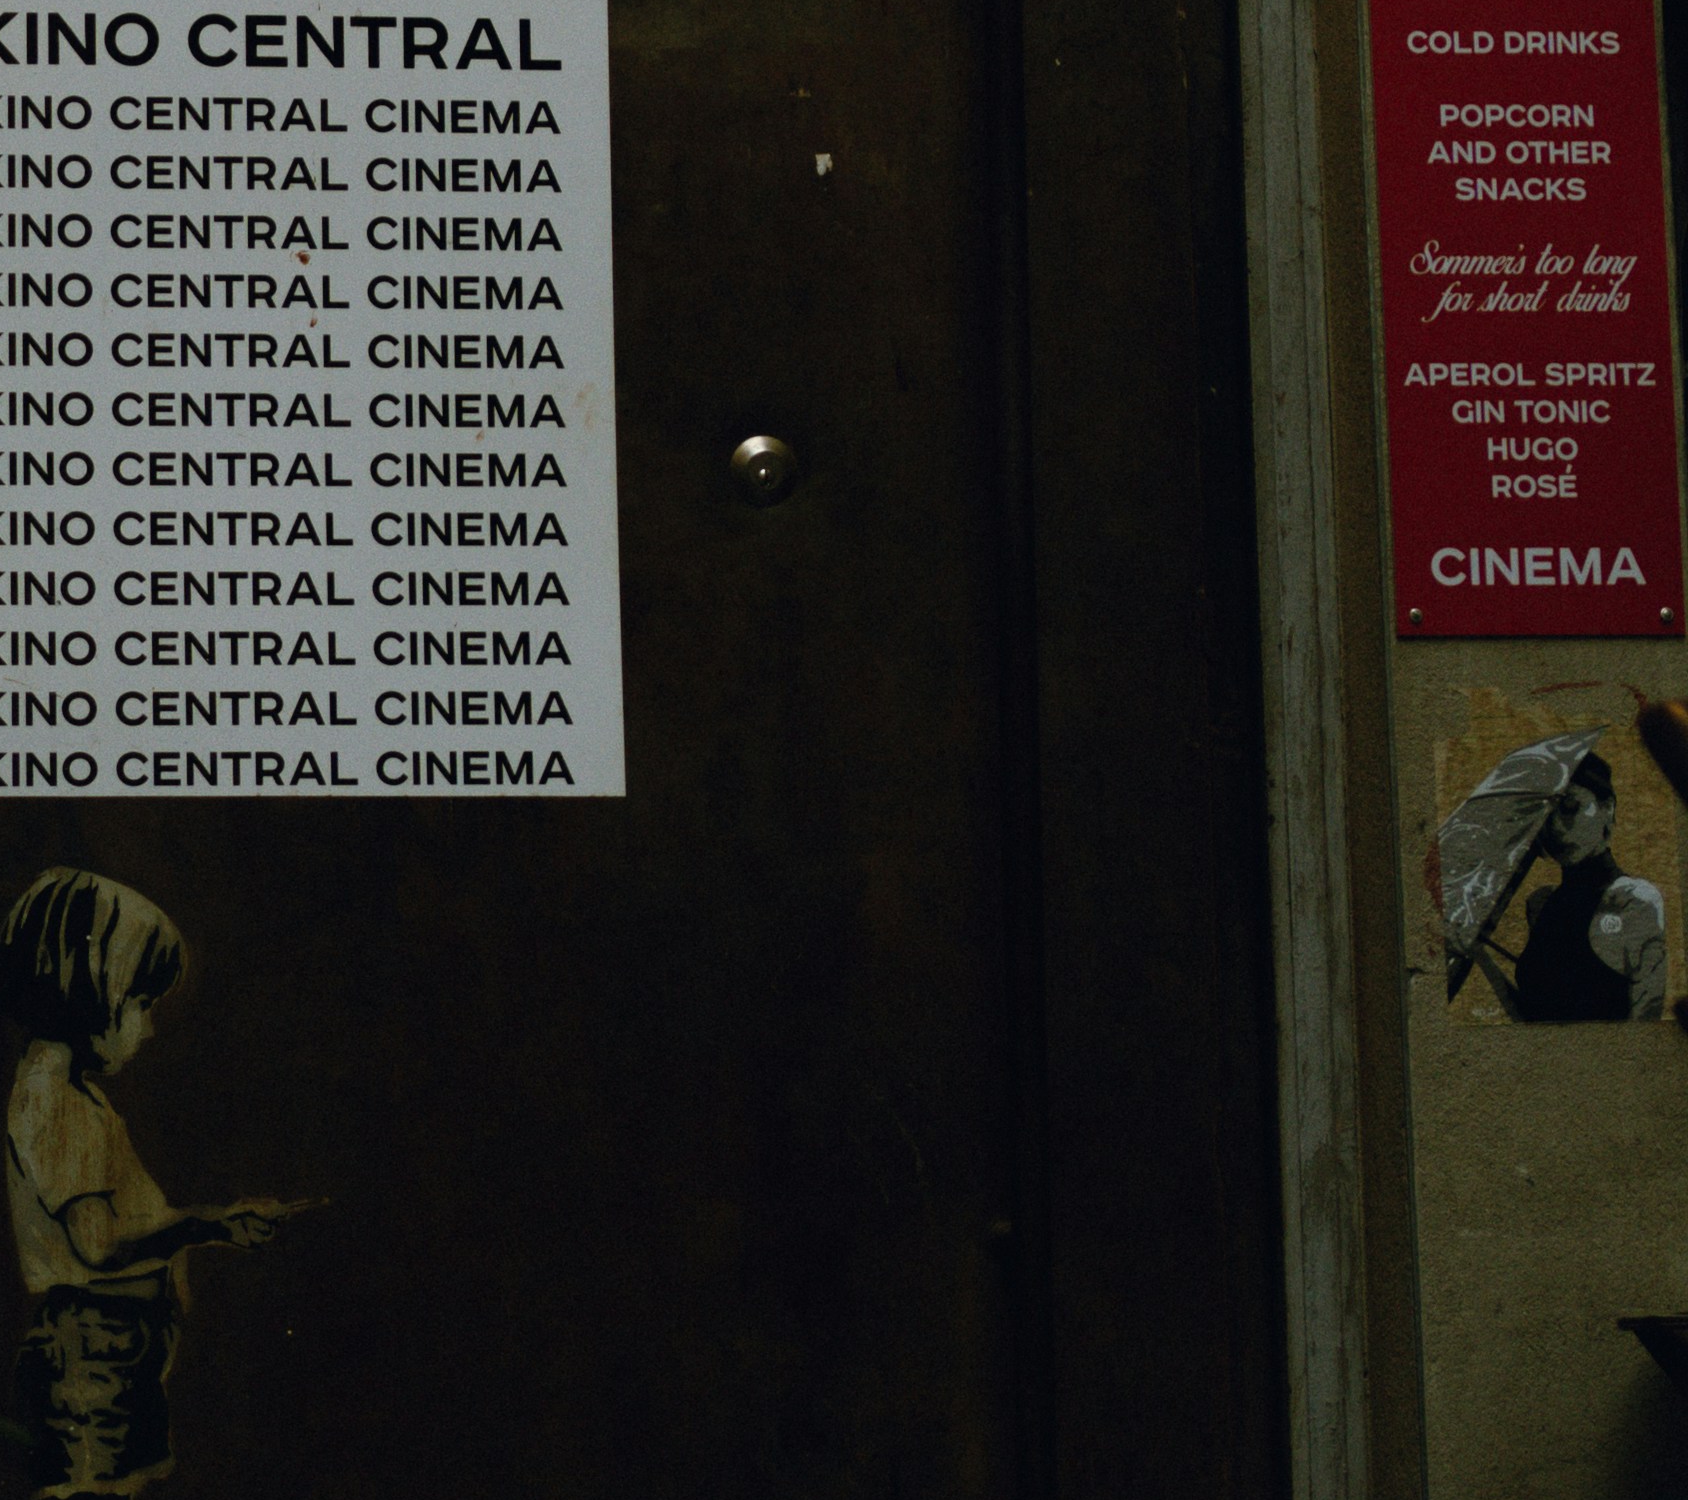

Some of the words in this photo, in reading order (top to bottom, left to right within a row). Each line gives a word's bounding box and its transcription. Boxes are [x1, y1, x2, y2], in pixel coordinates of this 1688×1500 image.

[188, 14, 561, 70] CENTRAL
[1407, 31, 1494, 53] COLD
[1504, 31, 1619, 54] DRINKS
[110, 97, 347, 132] CENTRAL
[365, 99, 560, 134] CINEMA
[1440, 104, 1594, 127] POPCORN
[1428, 141, 1496, 164] AND
[1506, 141, 1610, 164] OTHER
[110, 155, 348, 191] CENTRAL
[366, 158, 561, 192] CINEMA
[1456, 178, 1586, 201] SNACKS
[111, 214, 348, 249] CENTRAL
[367, 217, 562, 251] CINEMA
[1536, 244, 1574, 275] too
[1583, 244, 1637, 283] long
[111, 274, 349, 309] CENTRAL
[367, 275, 563, 310] CINEMA
[1422, 281, 1473, 322] for
[1478, 281, 1547, 313] short
[1557, 279, 1631, 313] drinks
[112, 333, 350, 368] CENTRAL
[368, 335, 564, 369] CINEMA
[1405, 363, 1535, 386] APEROL
[1546, 363, 1655, 386] SPRITZ
[112, 392, 351, 427] CENTRAL
[369, 394, 565, 428] CINEMA
[1452, 400, 1504, 423] GIN
[1514, 400, 1610, 423] TONIC
[1487, 437, 1578, 460] HUGO
[113, 452, 352, 486] CENTRAL
[370, 453, 566, 487] CINEMA
[1492, 464, 1577, 499] ROSÉ
[113, 512, 353, 546] CENTRAL
[371, 512, 567, 546] CINEMA
[1431, 548, 1645, 586] CINEMA
[114, 571, 354, 606] CENTRAL
[372, 572, 569, 606] CINEMA
[115, 631, 355, 666] CENTRAL
[374, 632, 570, 665] CINEMA
[116, 692, 357, 726] CENTRAL
[375, 691, 572, 725] CINEMA
[116, 752, 358, 786] CENTRAL
[376, 751, 574, 786] CINEMA
